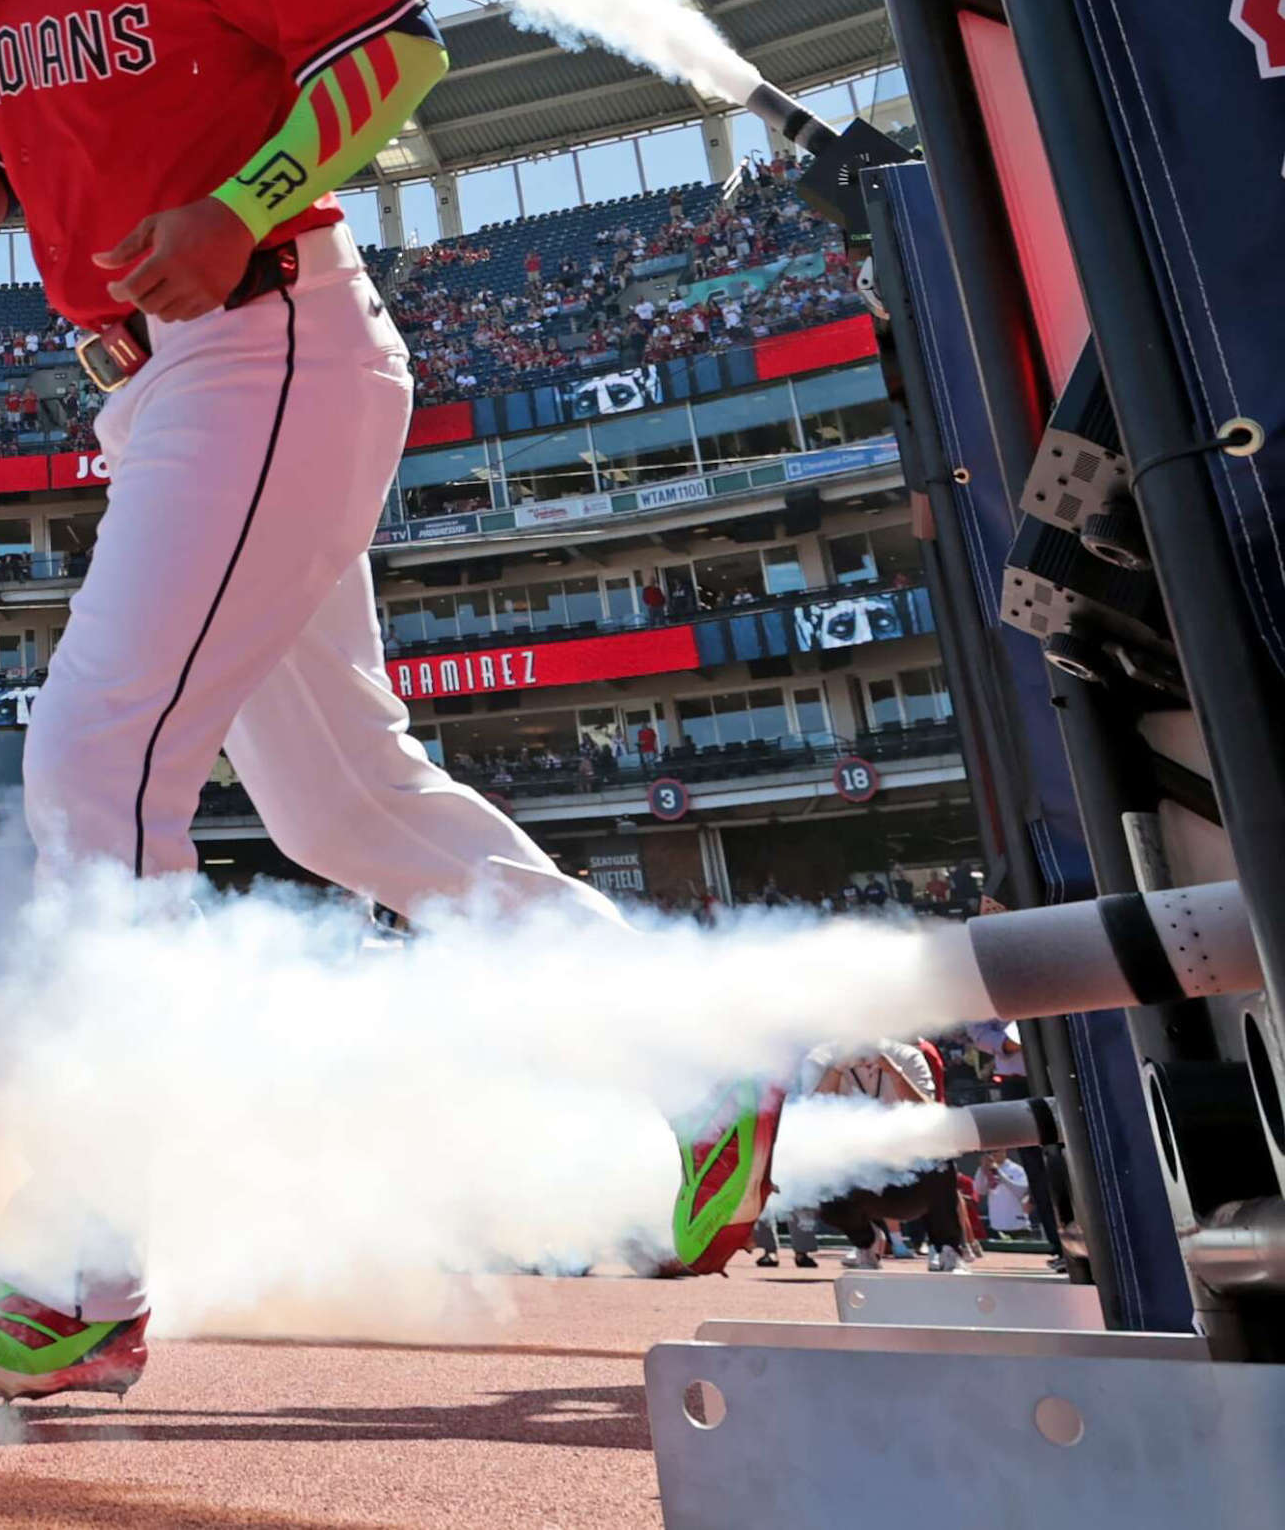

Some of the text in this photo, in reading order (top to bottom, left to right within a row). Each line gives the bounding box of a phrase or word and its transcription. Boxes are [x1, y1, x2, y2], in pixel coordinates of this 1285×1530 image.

[76, 454, 110, 480] JO
[640, 482, 705, 507] WTAM 1100
[841, 768, 870, 791] 18
[659, 788, 676, 809] 3
